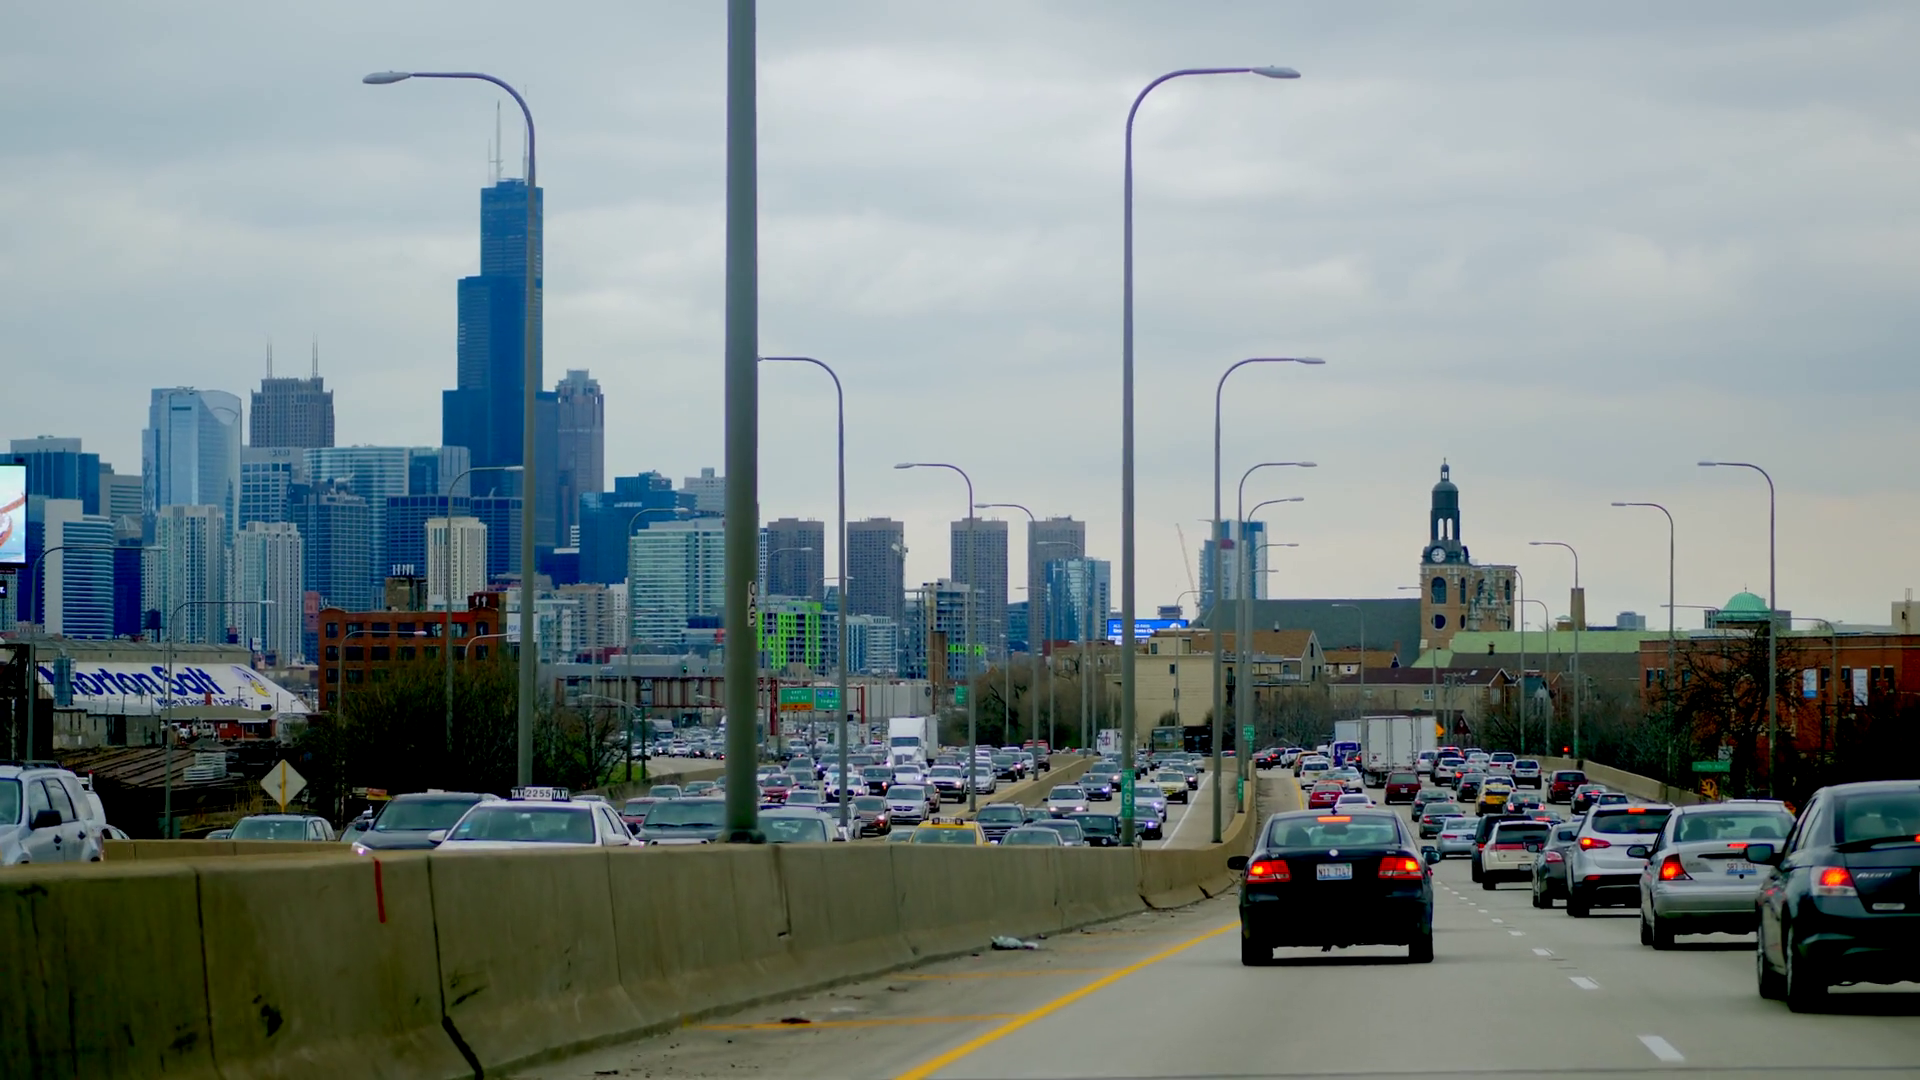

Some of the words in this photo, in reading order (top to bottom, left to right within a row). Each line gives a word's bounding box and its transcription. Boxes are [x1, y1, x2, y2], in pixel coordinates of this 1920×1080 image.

[151, 665, 226, 697] Salt
[525, 789, 551, 798] 2255
[552, 789, 568, 800] TAXI
